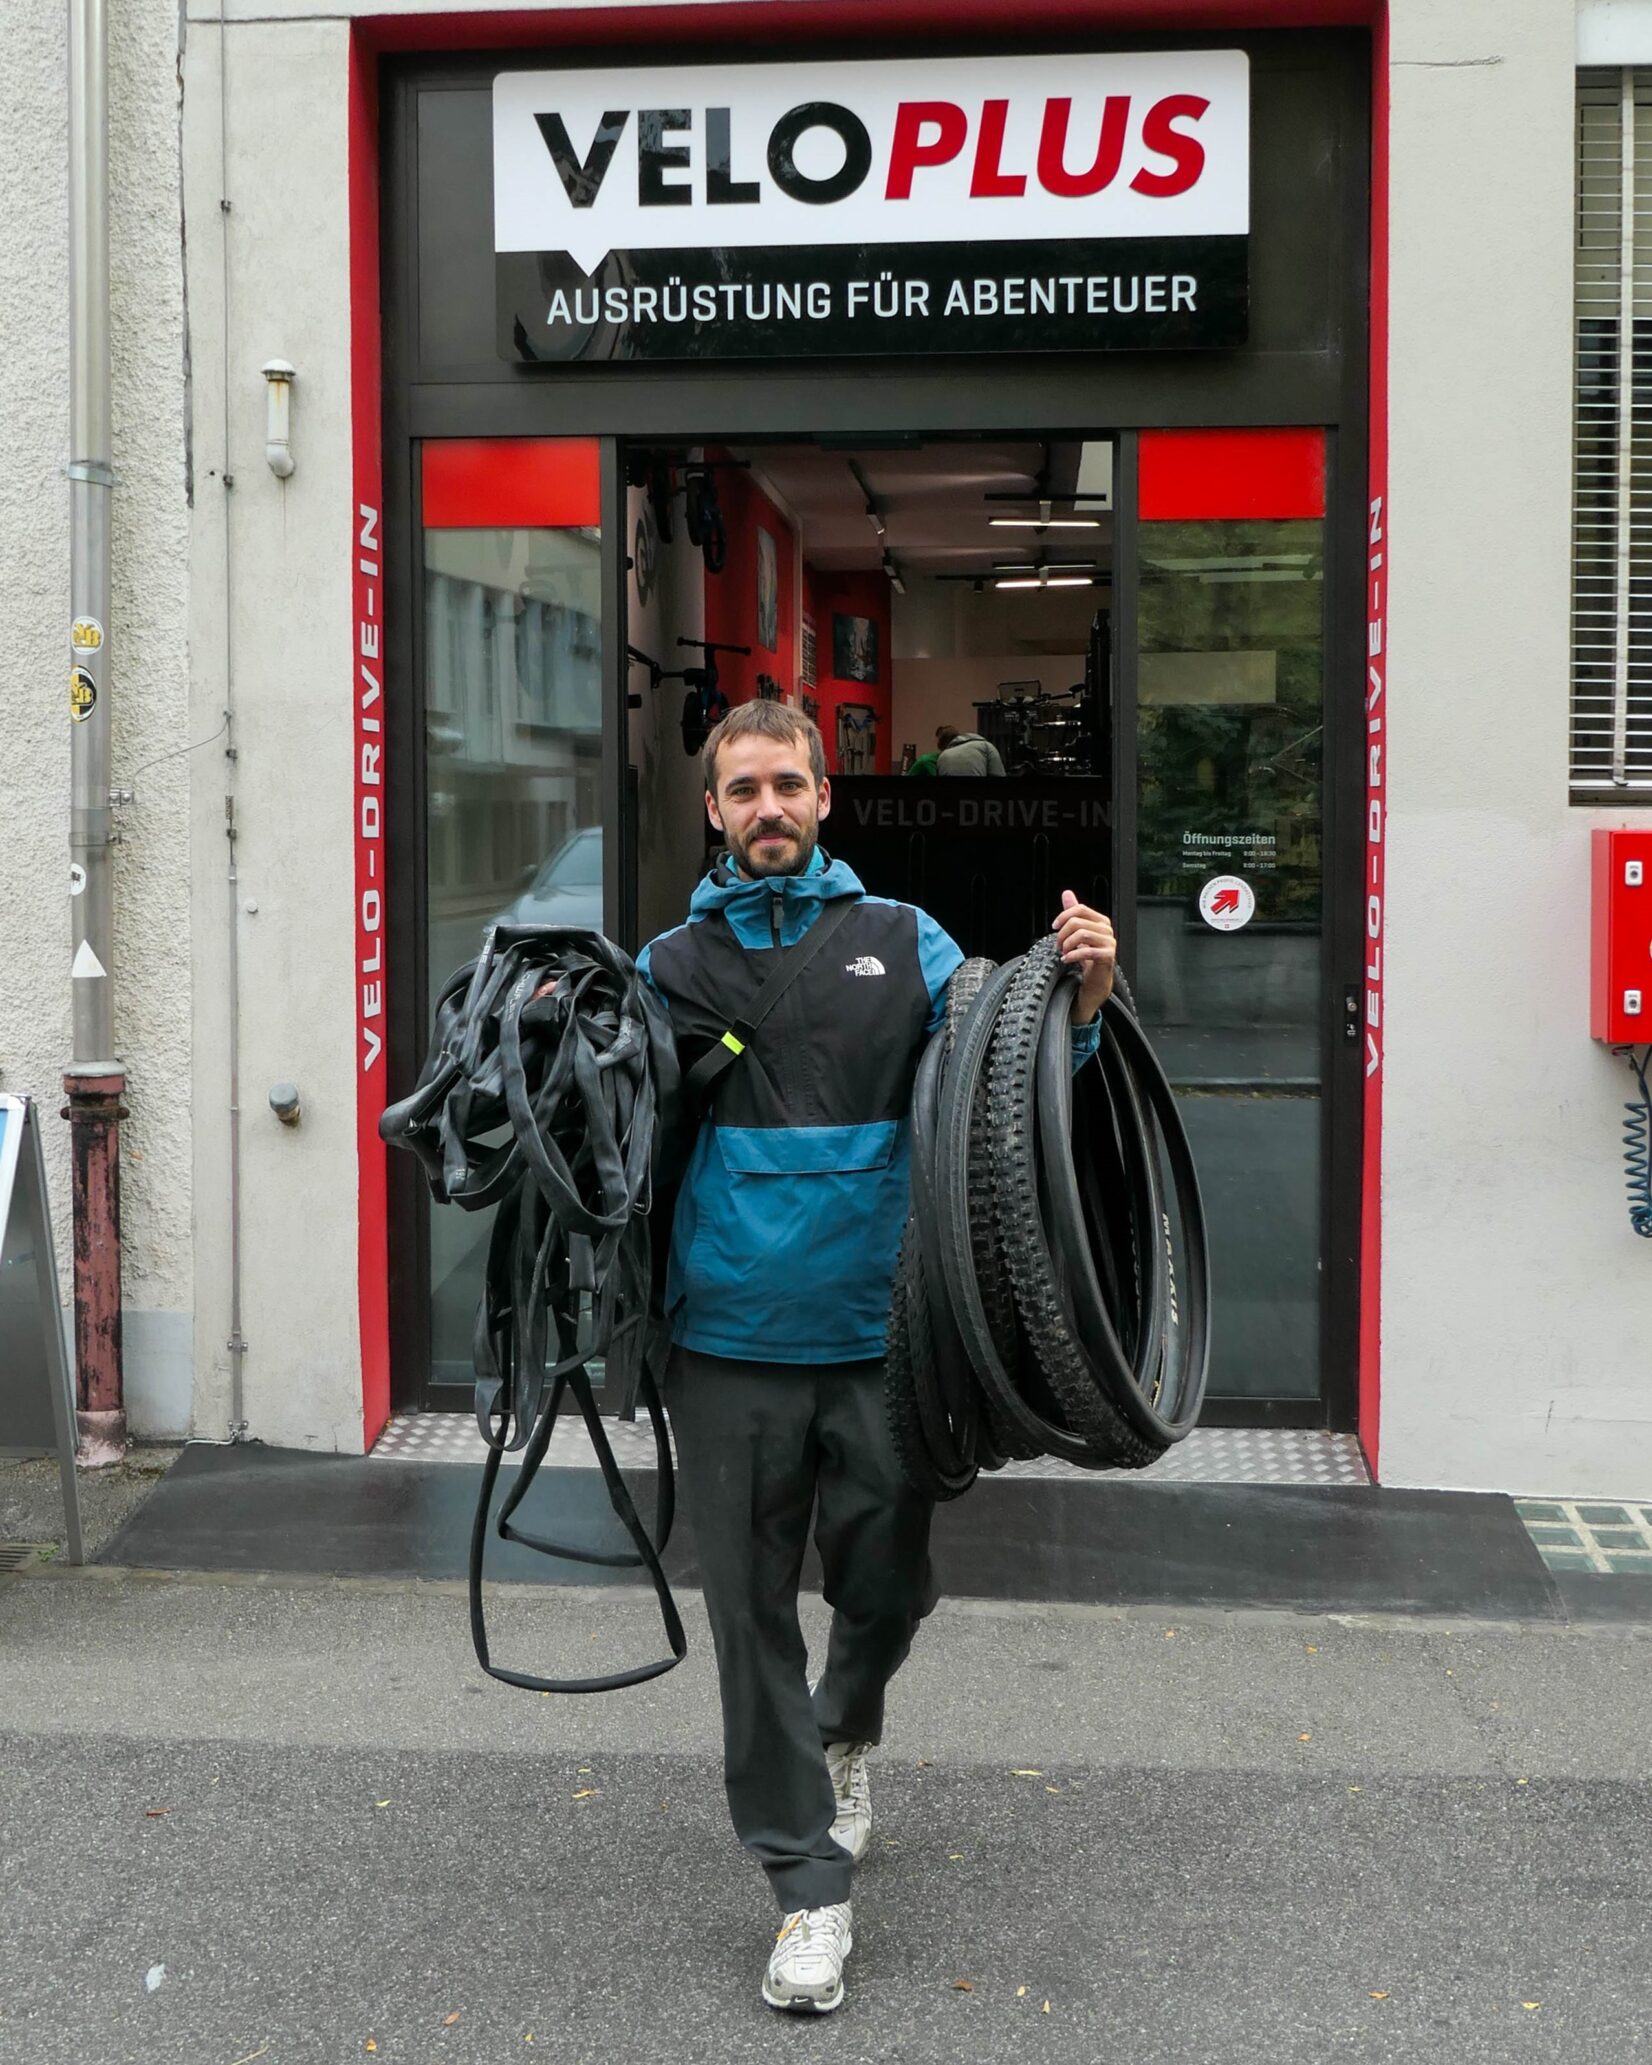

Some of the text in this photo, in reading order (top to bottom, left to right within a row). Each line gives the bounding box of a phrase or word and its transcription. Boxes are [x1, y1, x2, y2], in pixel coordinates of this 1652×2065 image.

[533, 94, 1211, 209] VELOPLUS
[546, 271, 1198, 325] AUSRÜSTUNG FÜR ABENTEUER
[359, 503, 381, 1072] VELO-DRIVE-IN
[1367, 496, 1382, 1078] VELO-DRIVE-IN
[853, 798, 1113, 828] VELO-DRIVE-IN
[1182, 830, 1276, 847] Öffnungszeiten
[845, 963, 872, 972] NORTH
[855, 969, 873, 977] FACE
